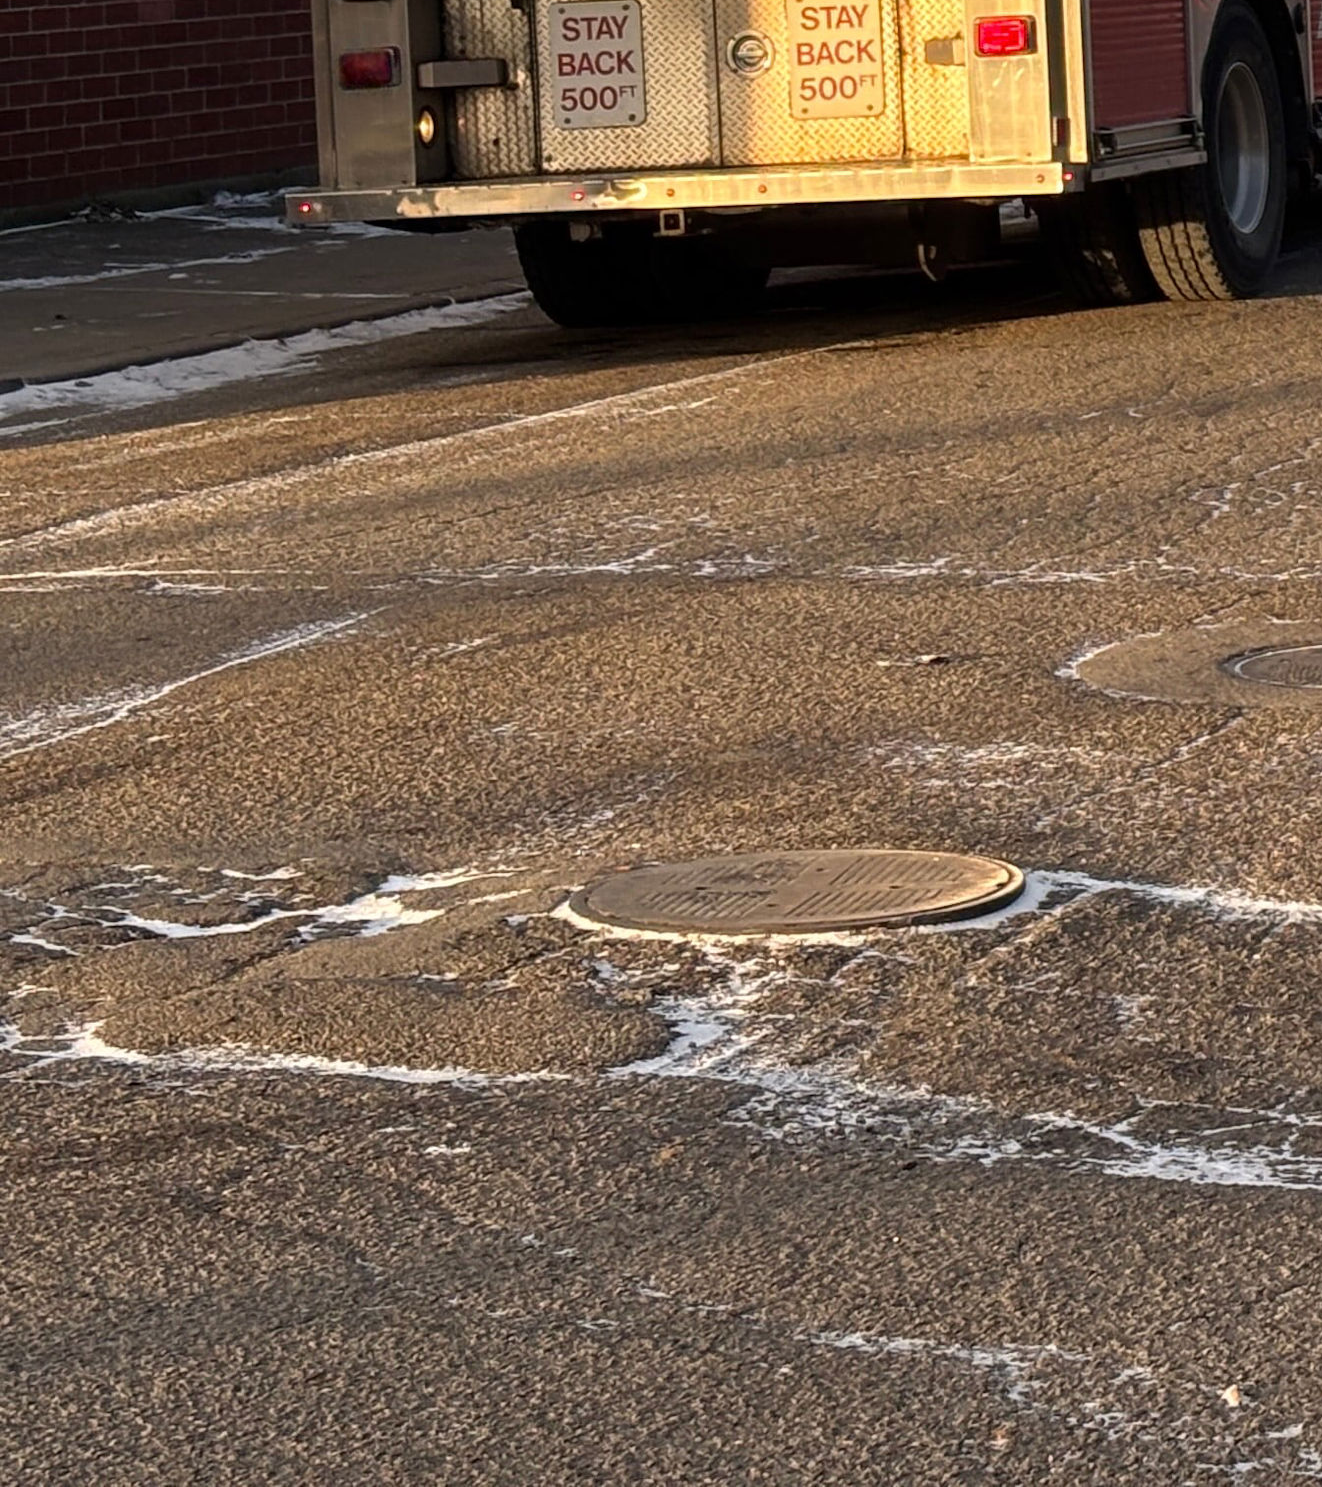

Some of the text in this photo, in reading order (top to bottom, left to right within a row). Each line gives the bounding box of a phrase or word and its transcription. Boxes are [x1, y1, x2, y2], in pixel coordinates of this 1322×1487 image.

[562, 15, 628, 41] STAY
[800, 4, 868, 30] STAY
[557, 50, 636, 77] BACK
[796, 39, 877, 66] BACK
